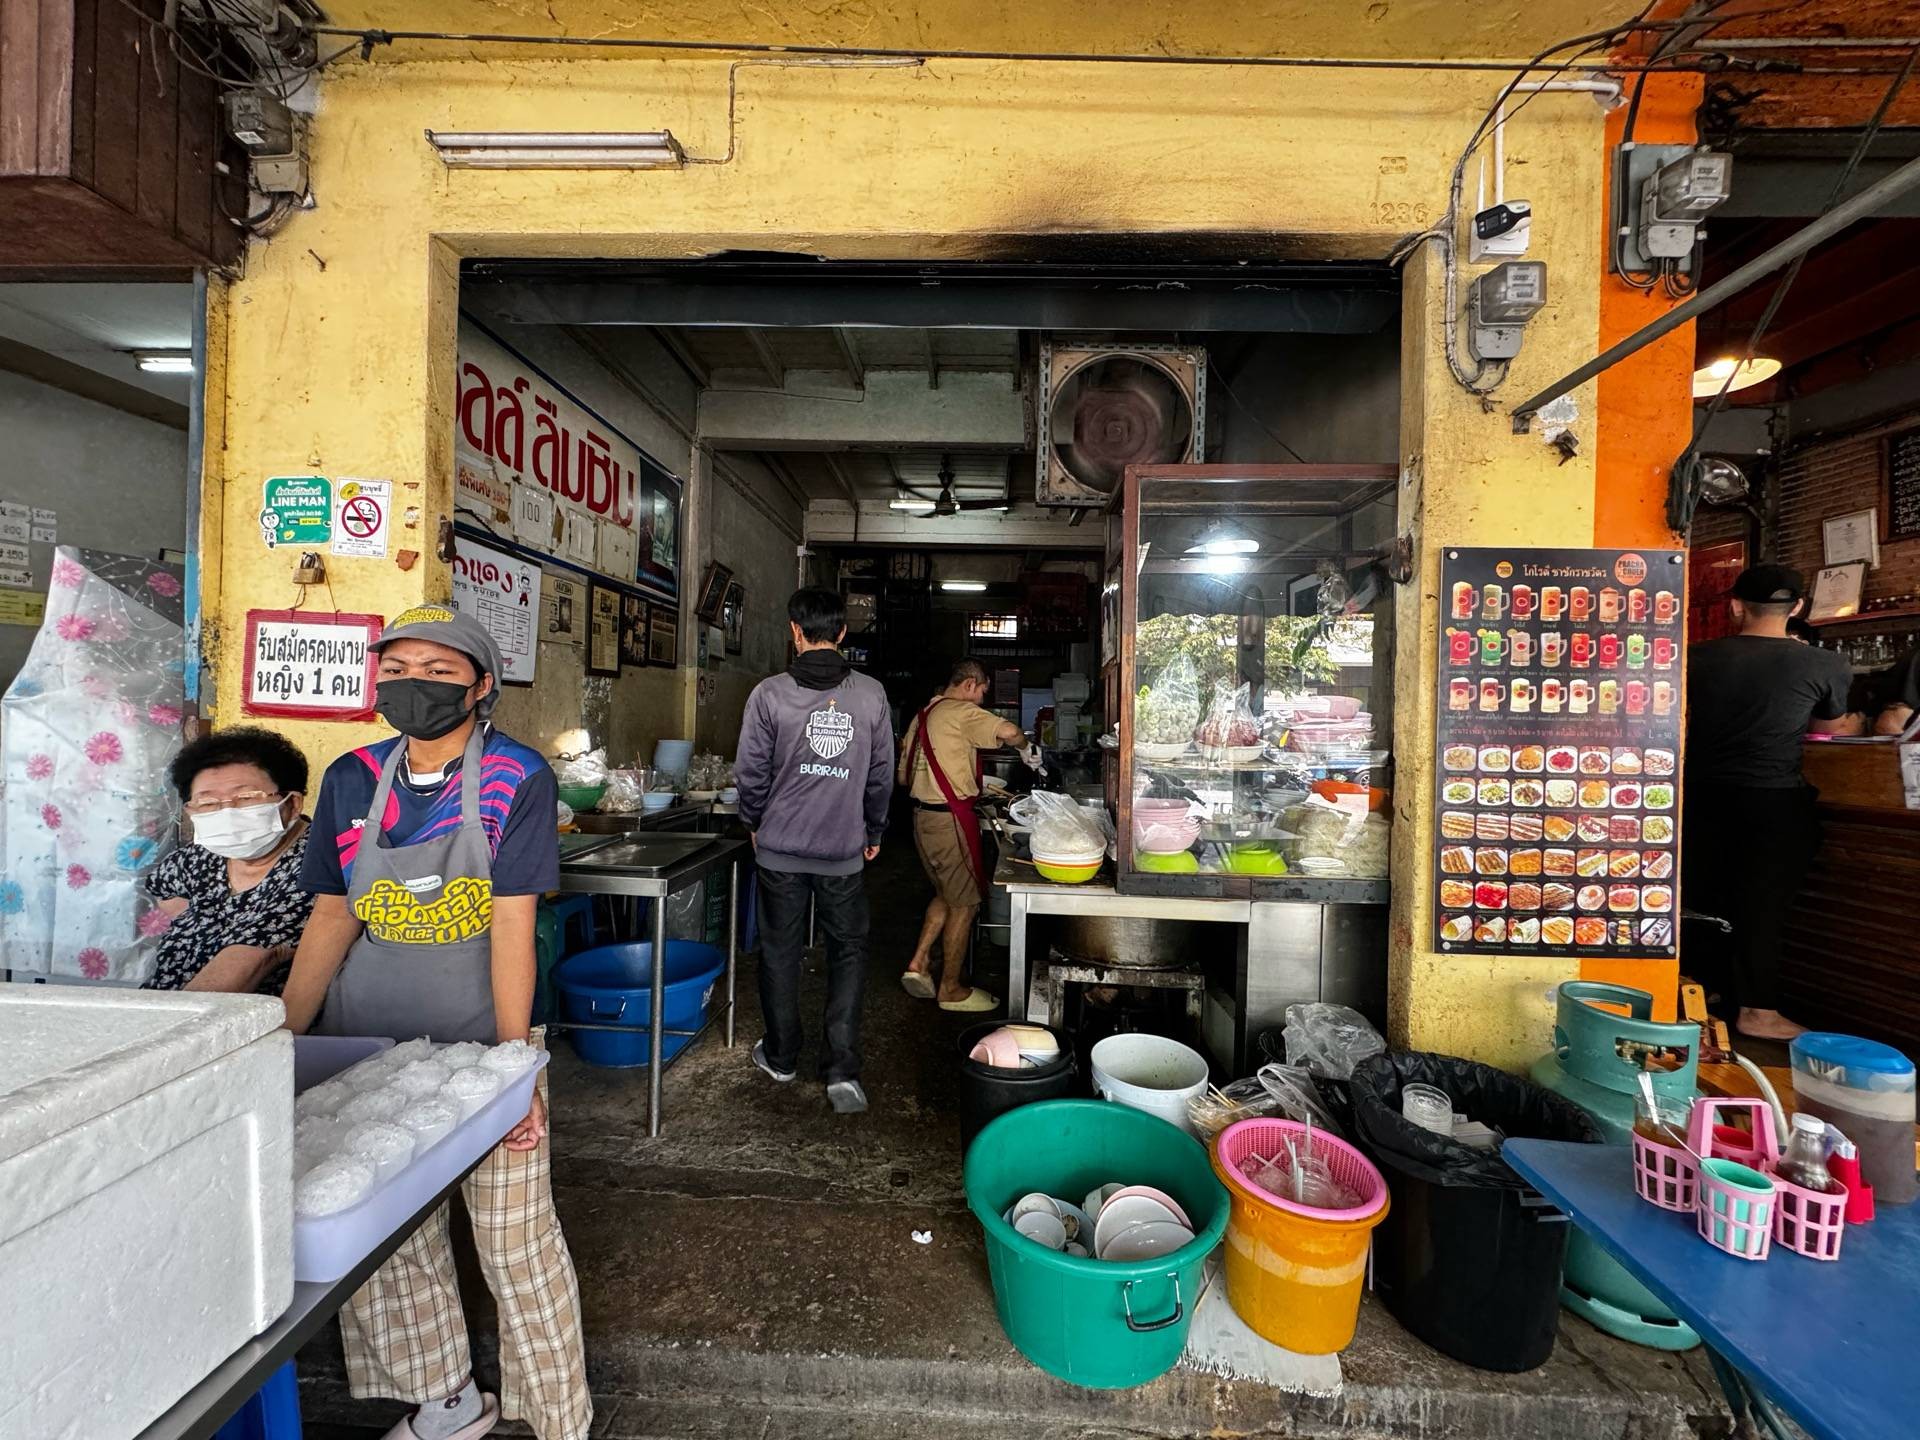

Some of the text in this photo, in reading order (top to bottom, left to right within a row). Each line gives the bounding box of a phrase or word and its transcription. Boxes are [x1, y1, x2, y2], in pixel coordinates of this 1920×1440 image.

[271, 496, 326, 507] LINE MAN
[258, 627, 365, 666] รับสมัครคนงาน
[257, 665, 360, 700] หญิง 1 คน
[800, 763, 850, 780] BURIRAM
[373, 885, 410, 906] ร้าน
